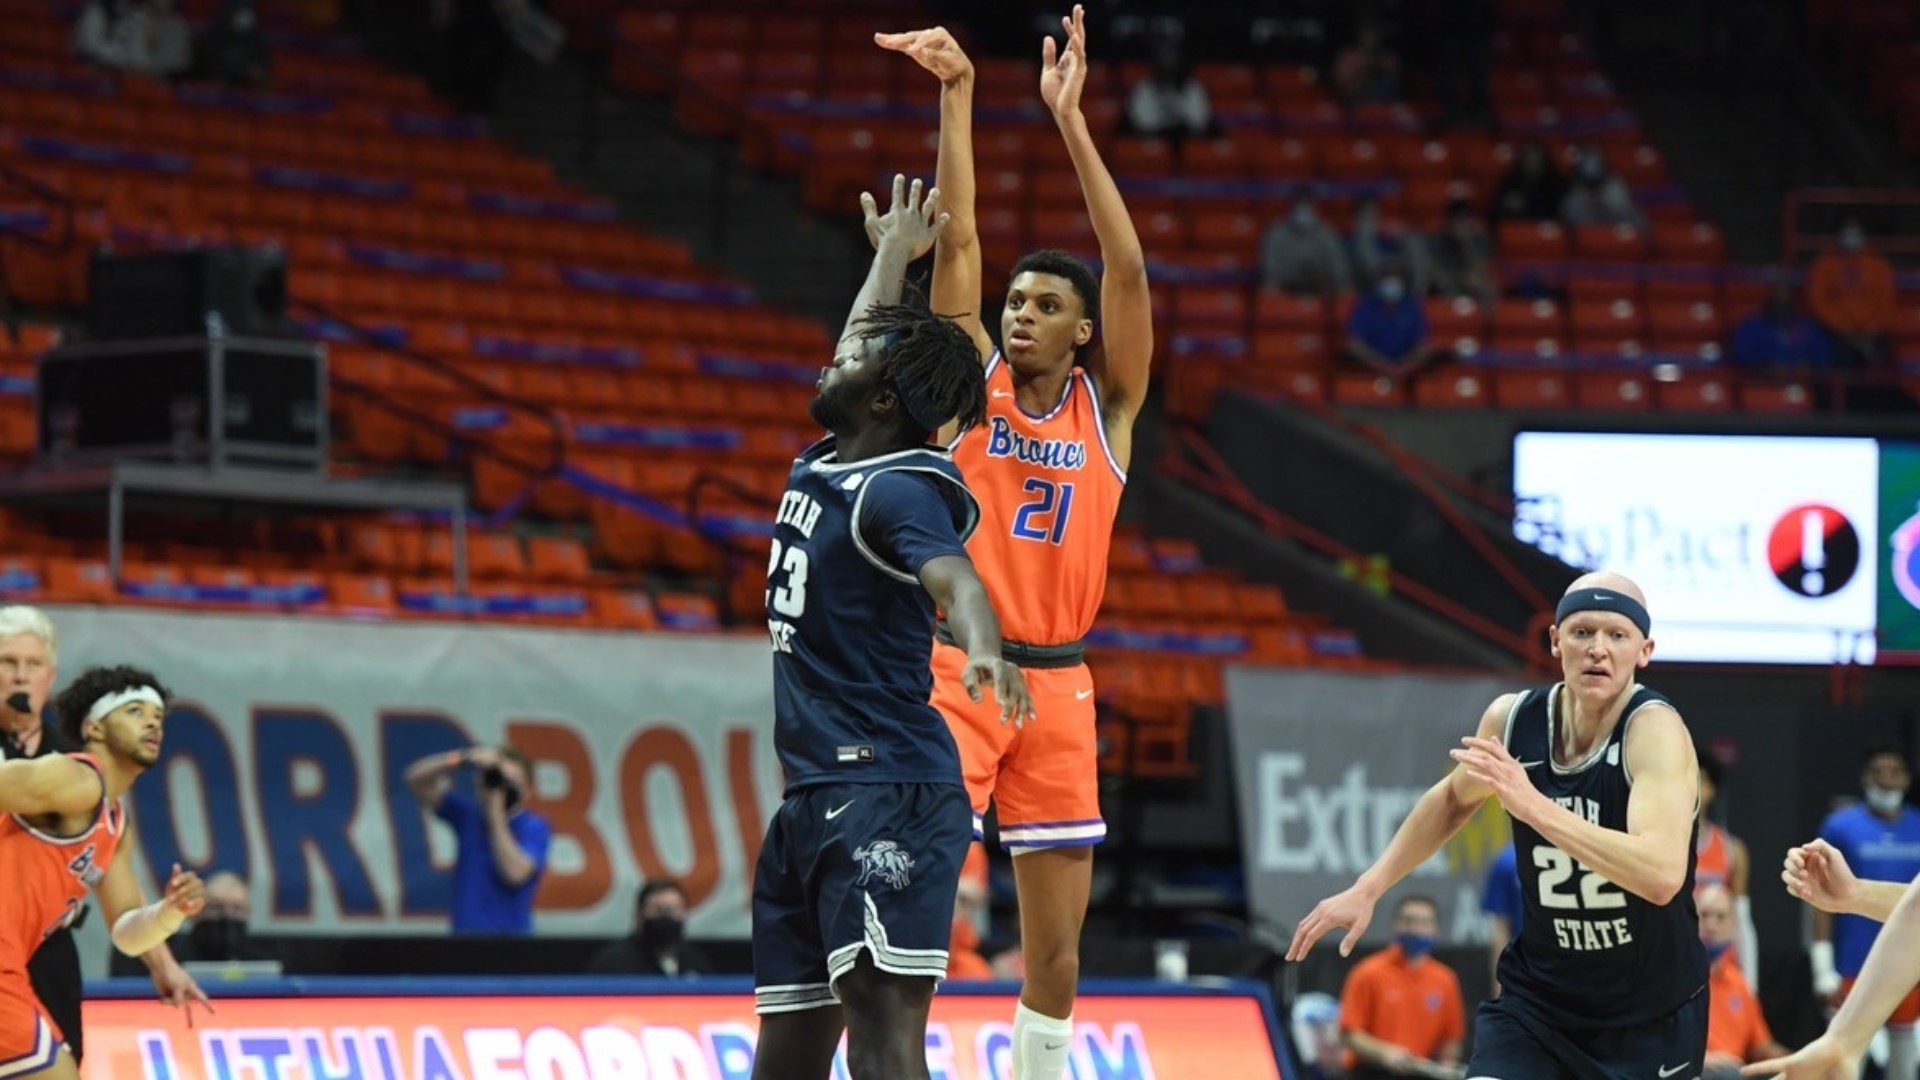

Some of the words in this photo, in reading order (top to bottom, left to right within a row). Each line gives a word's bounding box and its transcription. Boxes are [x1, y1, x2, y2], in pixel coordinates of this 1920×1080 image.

[1010, 476, 1075, 546] 21
[1551, 796, 1600, 827] TAH
[1532, 845, 1627, 909] 22
[1553, 917, 1633, 950] STATE
